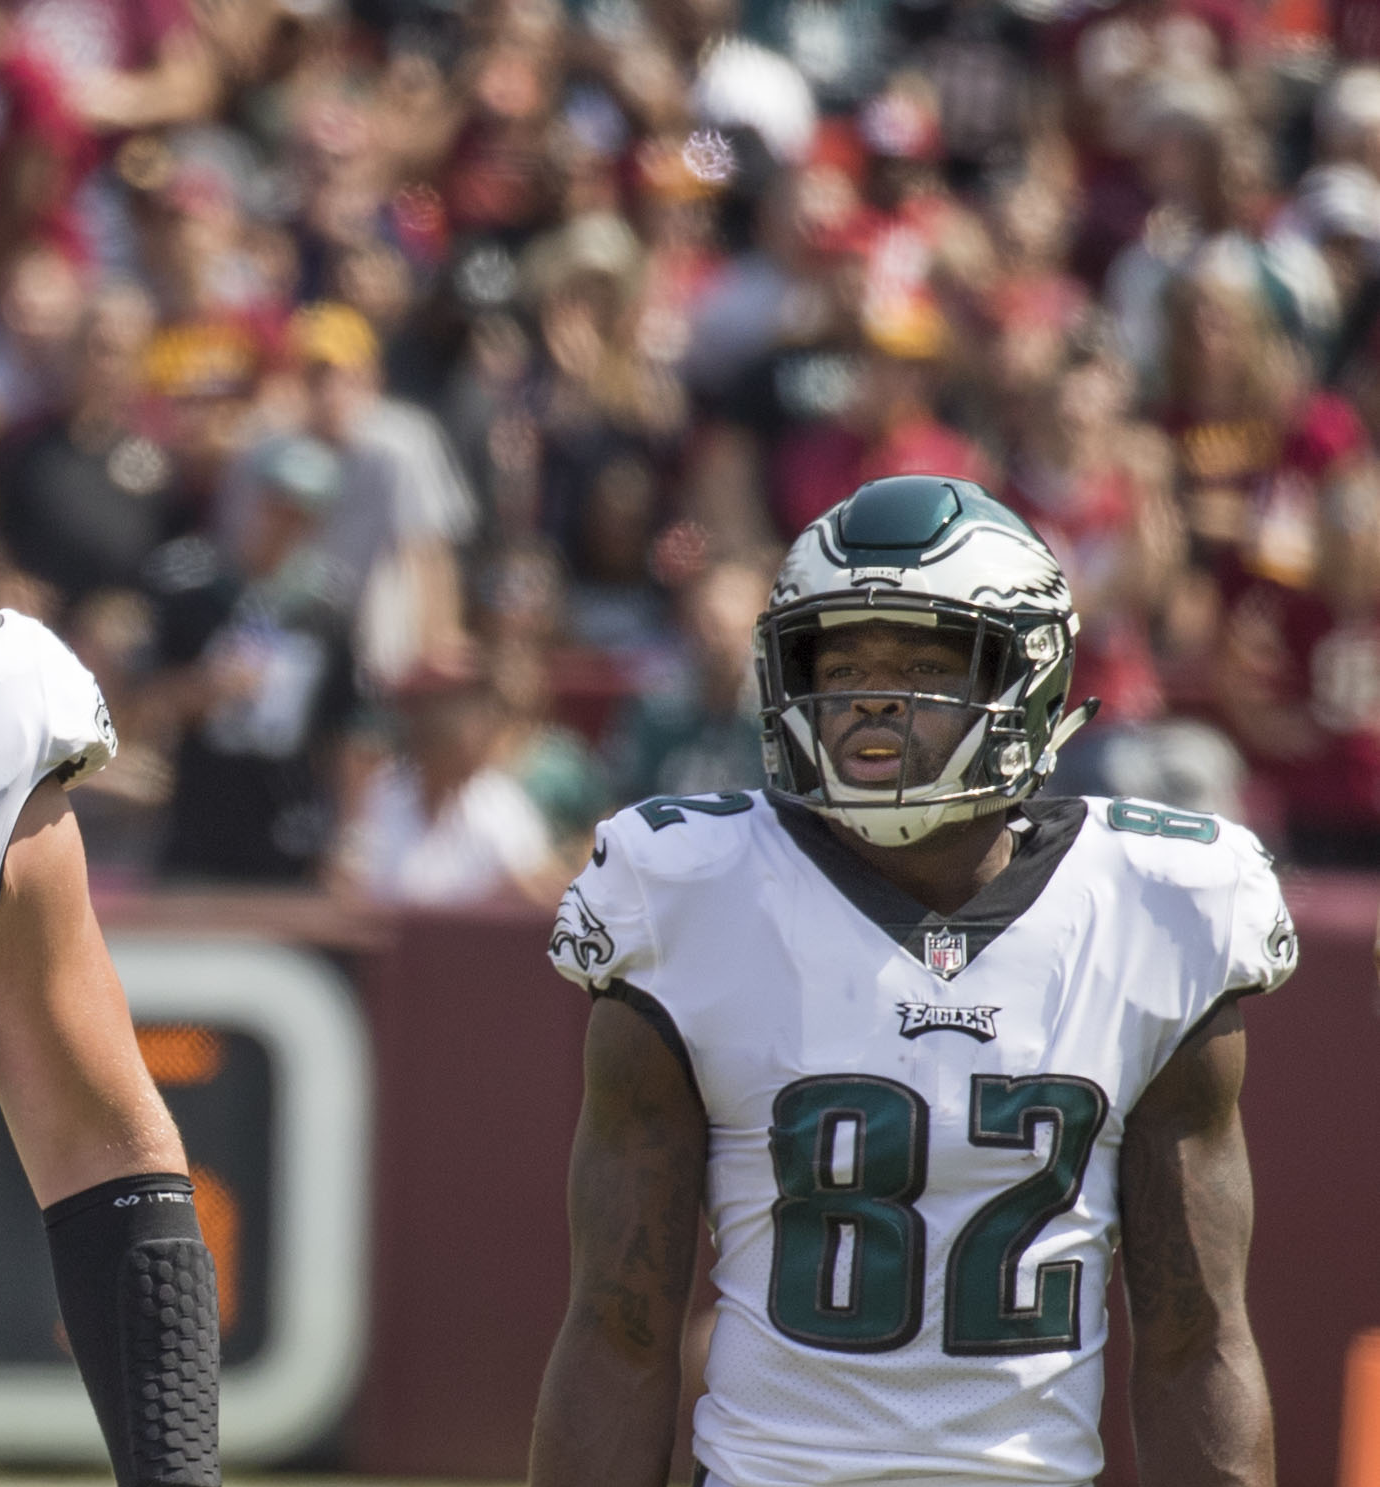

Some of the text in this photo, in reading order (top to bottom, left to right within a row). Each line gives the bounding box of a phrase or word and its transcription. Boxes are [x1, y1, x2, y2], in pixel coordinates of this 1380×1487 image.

[932, 950, 960, 969] NFL
[896, 1002, 1003, 1044] EAGLES
[157, 1192, 194, 1205] HEX
[767, 1073, 1110, 1357] 82
